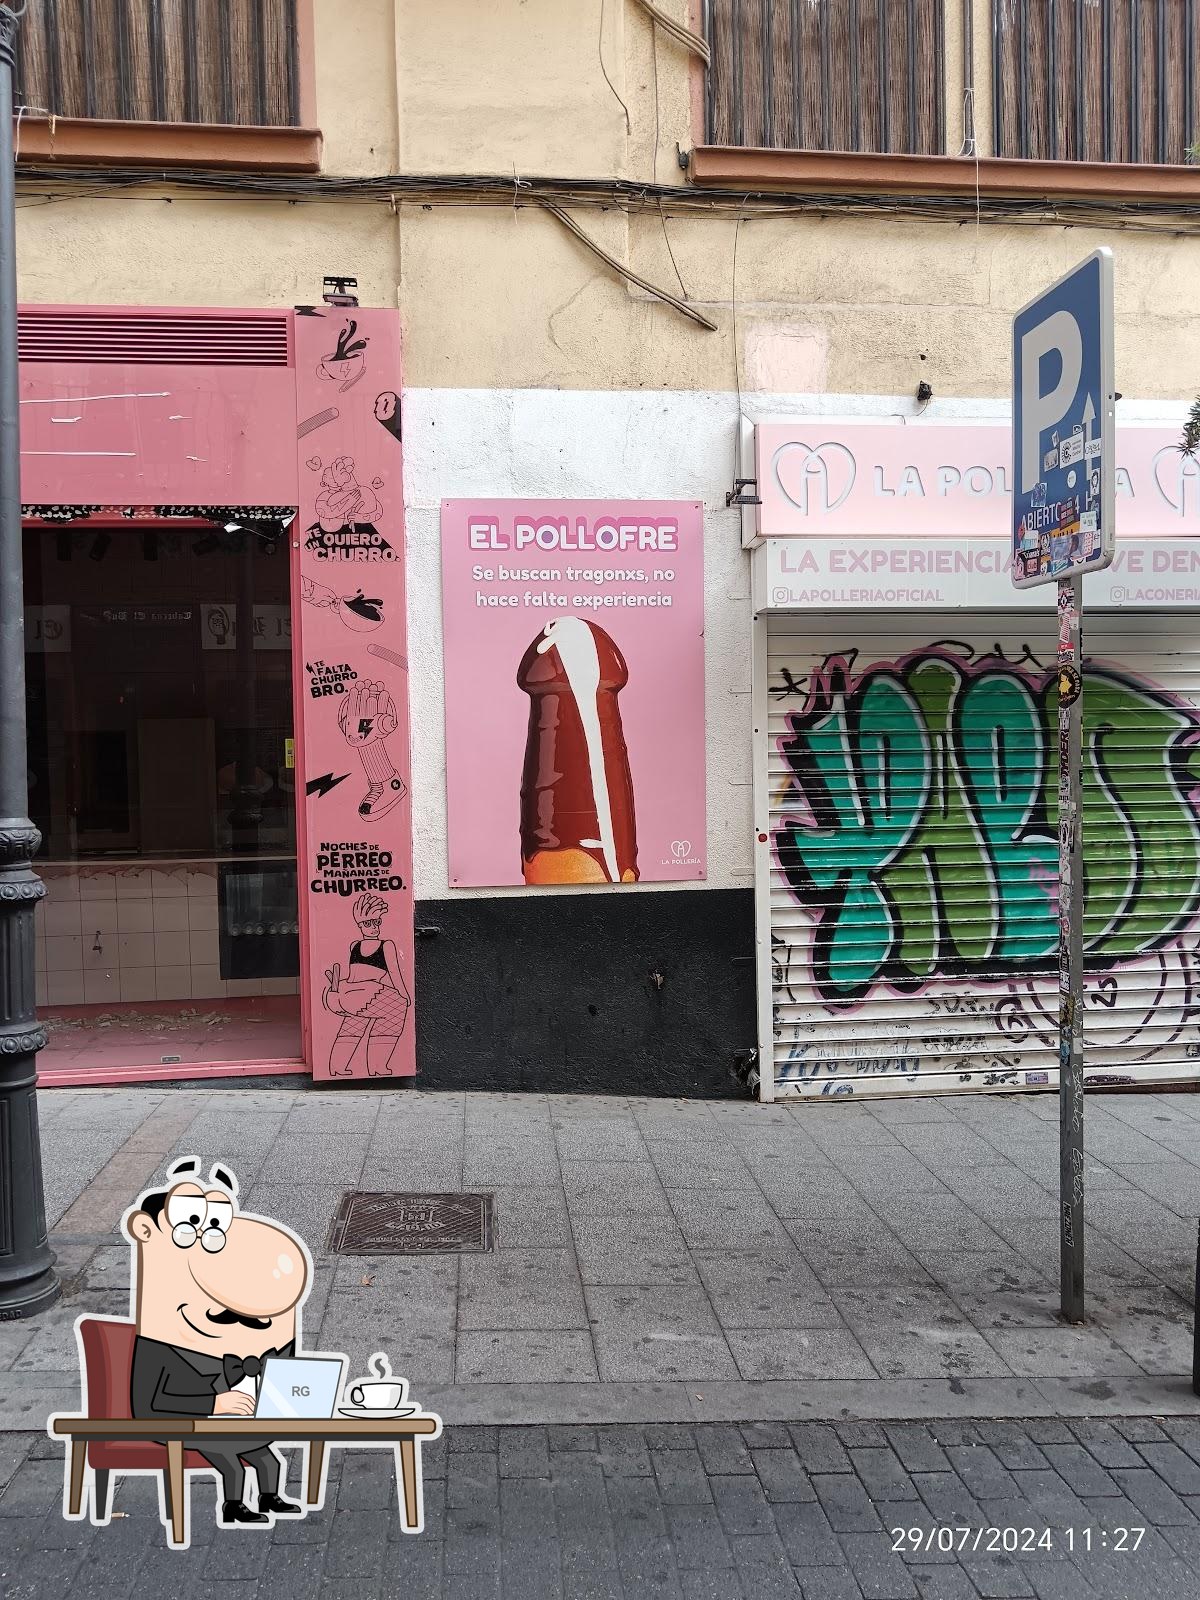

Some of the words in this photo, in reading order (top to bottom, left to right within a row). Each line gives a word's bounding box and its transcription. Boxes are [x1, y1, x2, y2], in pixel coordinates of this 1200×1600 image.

[1021, 310, 1083, 494] P
[873, 465, 926, 497] LA
[306, 527, 322, 540] TE
[323, 533, 383, 546] QUIERO
[469, 519, 509, 550] EL
[515, 519, 678, 551] POLLOFRE
[304, 540, 320, 552] UN
[780, 549, 820, 574] LA
[472, 565, 494, 581] Se
[498, 565, 562, 581] buscan
[566, 566, 649, 585] tragonxs,
[653, 570, 676, 581] no
[476, 591, 519, 607] hace
[523, 591, 568, 607] falta
[572, 591, 673, 611] experiencia
[790, 588, 945, 602] LAPOLLERIAOFICIAL
[313, 660, 325, 668] TE
[317, 663, 352, 675] FALTA
[311, 671, 358, 685] CHURRO
[310, 682, 349, 699] BRO.
[320, 842, 368, 852] NOCHES
[316, 851, 393, 871] PERREO
[323, 868, 380, 878] MAÑANAS
[310, 876, 407, 897] CHURREO.
